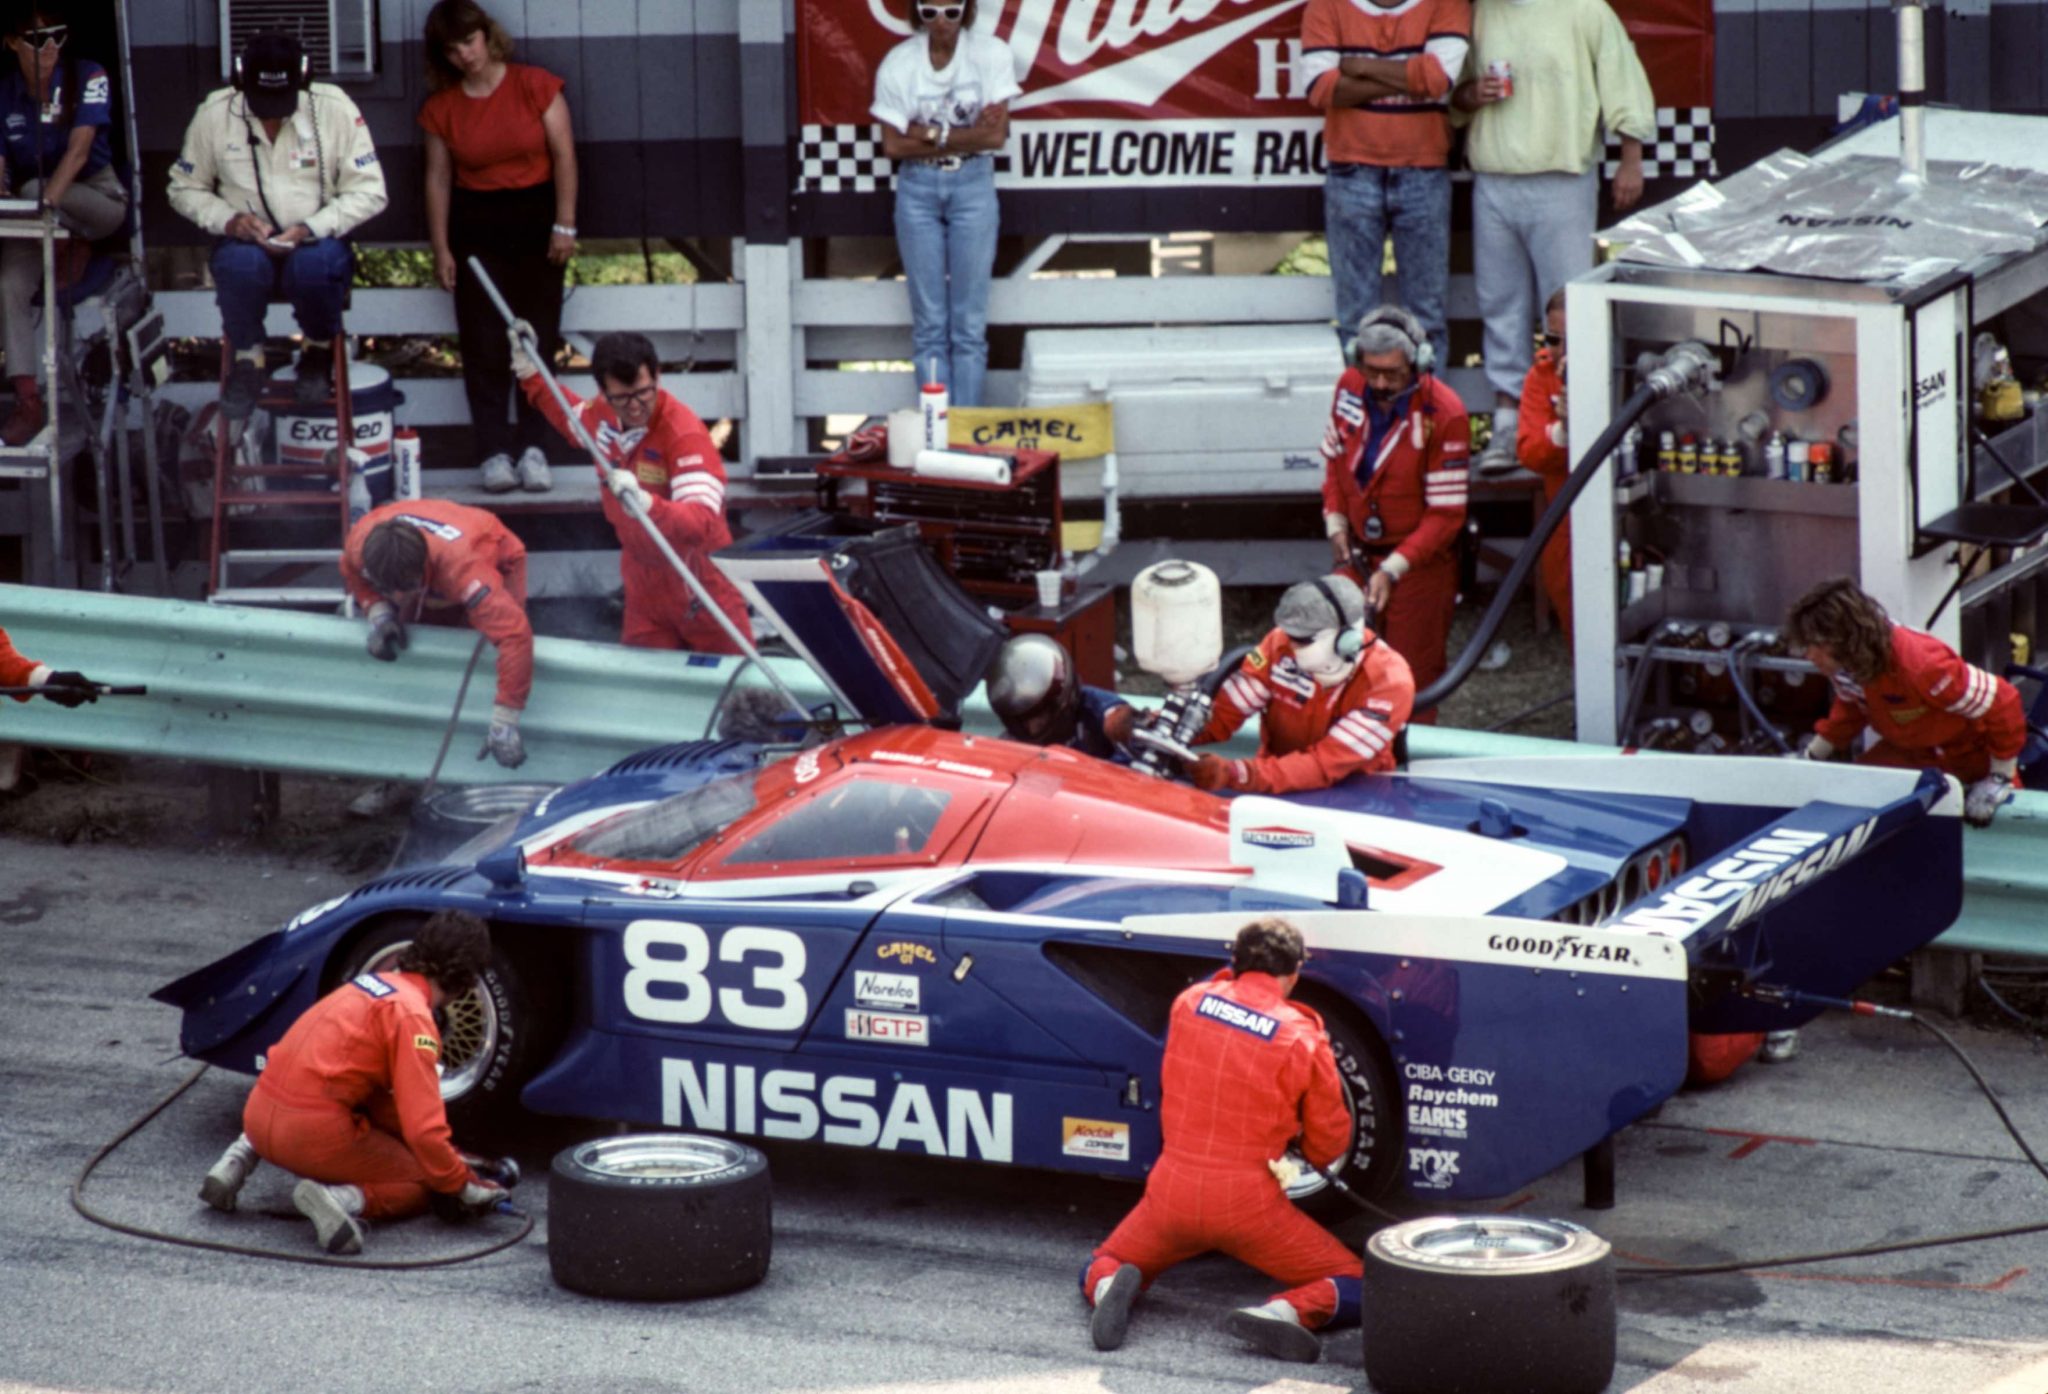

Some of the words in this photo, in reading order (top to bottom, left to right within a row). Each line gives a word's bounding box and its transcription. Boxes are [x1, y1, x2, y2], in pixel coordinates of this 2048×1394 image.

[1020, 132, 1234, 178] WELCOME
[1777, 213, 1913, 230] NISSAN
[972, 418, 1083, 446] CAMEL
[1725, 815, 1879, 931] NISSAN
[877, 942, 937, 963] CAMEL
[1488, 934, 1632, 963] GOODYEAR
[622, 919, 809, 1031] 83
[858, 973, 914, 998] Norelco
[871, 1017, 923, 1038] GTP
[1199, 996, 1277, 1036] NISSAN
[1327, 1032, 1376, 1170] ODYEAR
[1408, 1084, 1499, 1107] Raychem
[661, 1057, 1014, 1163] NISSAN
[1408, 1105, 1468, 1129] EARL'S
[1073, 1125, 1116, 1138] Kodak
[1408, 1148, 1460, 1175] FOX
